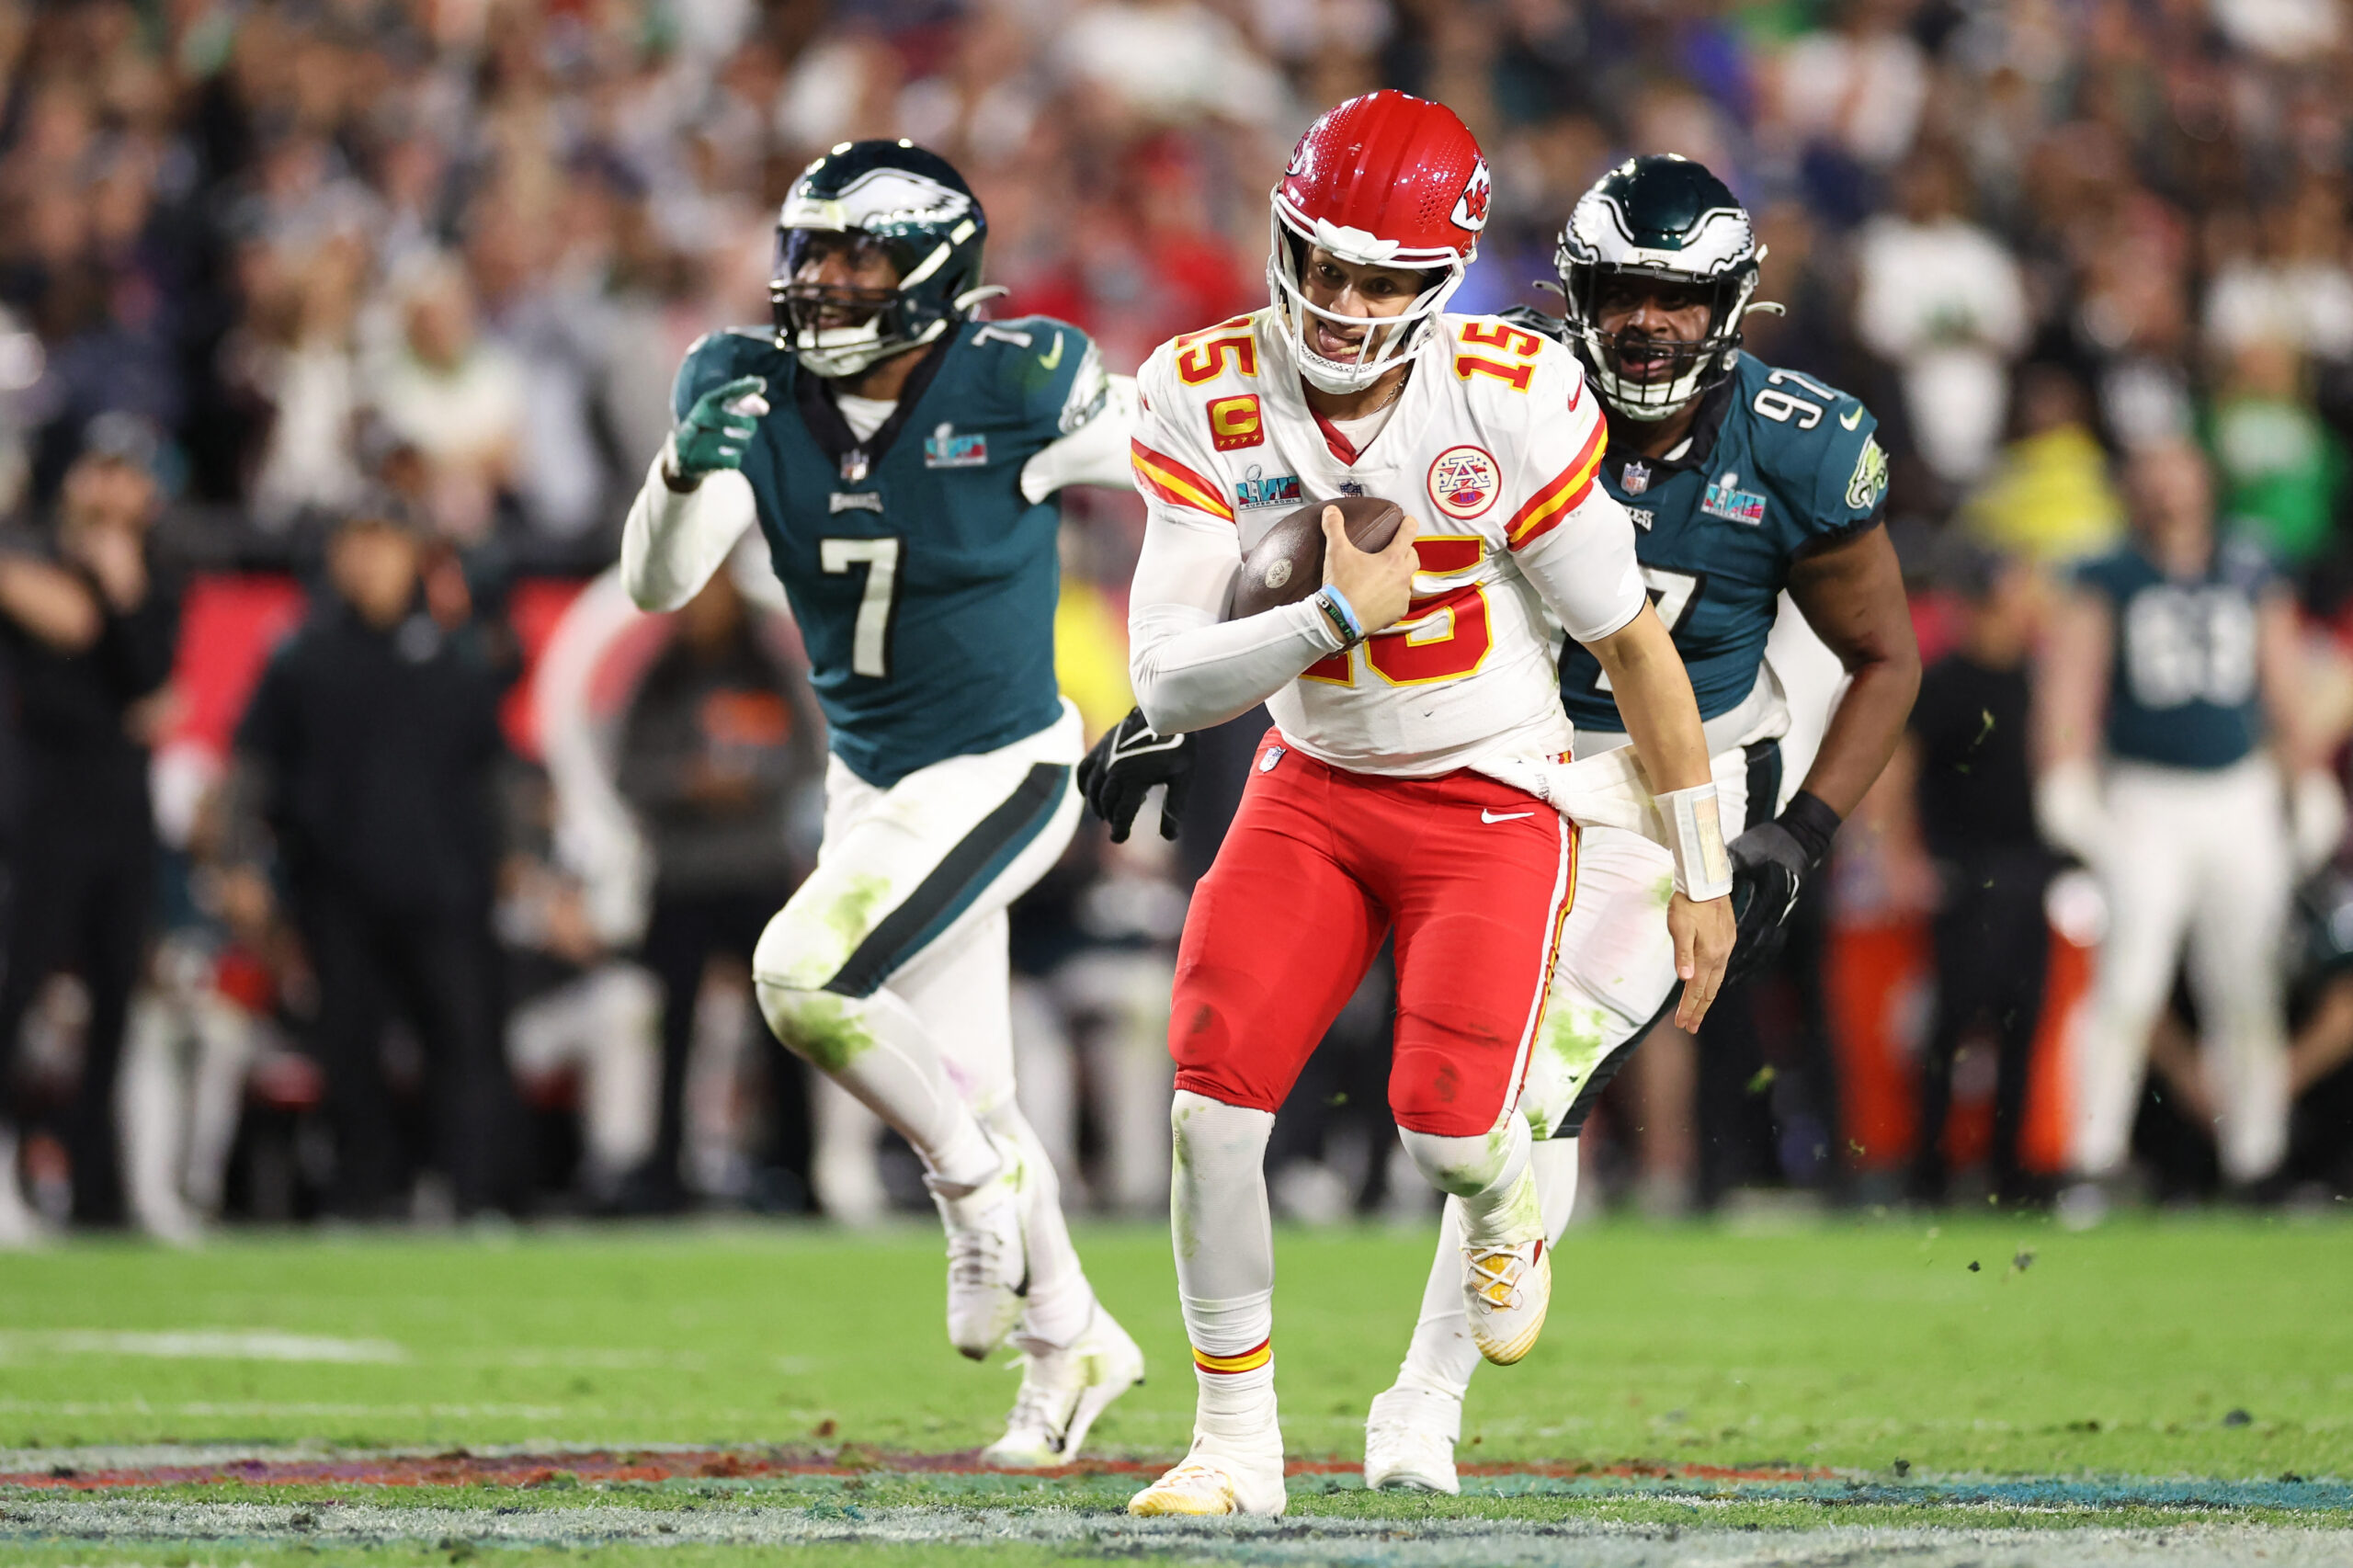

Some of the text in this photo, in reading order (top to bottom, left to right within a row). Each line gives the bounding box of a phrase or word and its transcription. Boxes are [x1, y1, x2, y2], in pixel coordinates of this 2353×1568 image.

[1176, 315, 1257, 387] 15
[1454, 322, 1545, 395] 15
[1211, 398, 1258, 437] C
[1753, 370, 1836, 429] 97
[1438, 455, 1491, 494] A
[821, 538, 899, 678] 7
[1297, 535, 1494, 688] 5
